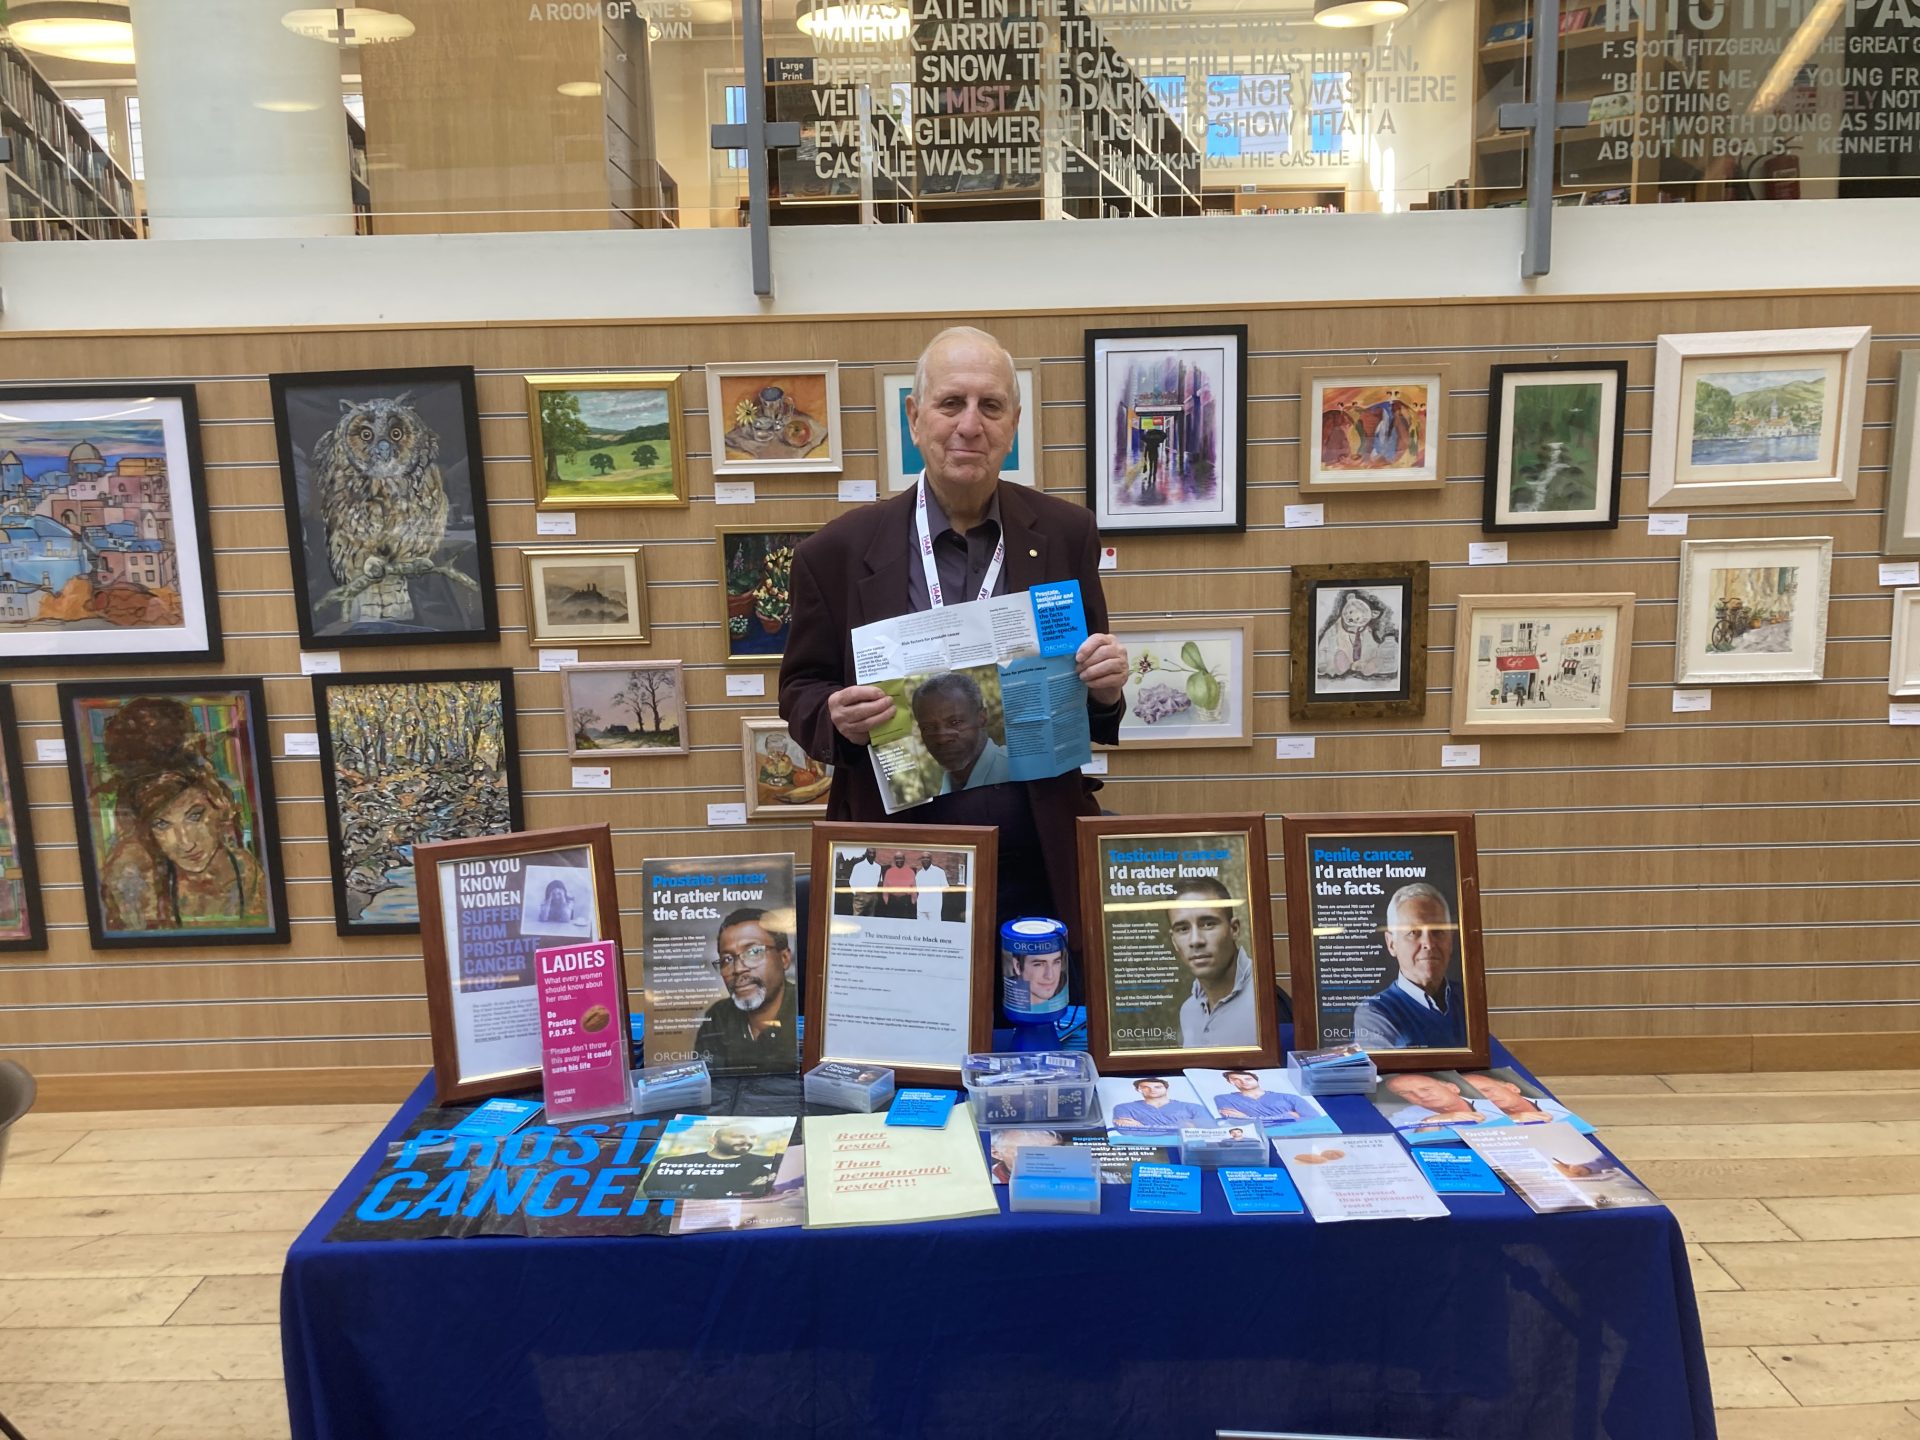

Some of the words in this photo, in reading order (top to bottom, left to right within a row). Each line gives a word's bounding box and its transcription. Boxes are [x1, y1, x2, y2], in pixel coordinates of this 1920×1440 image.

[529, 3, 543, 21] A
[546, 3, 600, 21] ROOM
[607, 2, 631, 19] OF
[981, 0, 1009, 19] IN
[932, 21, 1049, 50] ARRIVED
[1060, 21, 1114, 48] THE
[1602, 41, 1619, 59] F.
[1623, 40, 1676, 58] SCOTT
[1850, 36, 1910, 54] GREAT
[780, 61, 804, 72] Large
[813, 57, 883, 85] DEEP
[922, 54, 1012, 82] SNOW.
[1017, 53, 1071, 80] THE
[1251, 48, 1304, 74] HAS
[782, 71, 803, 81] Print
[1807, 67, 1883, 88] YOUNG
[913, 87, 940, 114] IN
[946, 85, 1010, 113] MIST
[1014, 84, 1073, 112] AND
[1080, 80, 1231, 111] DARKNESS,
[1239, 79, 1294, 106] NOR
[1300, 77, 1361, 104] WAS
[1367, 75, 1456, 103] THERE
[1635, 93, 1730, 113] NOTHING
[815, 119, 887, 148] EVEN
[891, 119, 912, 146] A
[915, 116, 1040, 145] GLIMMER
[1046, 115, 1082, 142] OF
[1092, 112, 1169, 142] LIGHT
[1215, 110, 1297, 138] SHOW
[1307, 108, 1373, 136] THAT
[1377, 108, 1396, 134] A
[1601, 116, 1666, 138] MUCH
[1673, 114, 1755, 135] WORTH
[1763, 112, 1833, 133] DOING
[1839, 112, 1868, 131] AS
[1597, 139, 1675, 161] ABOUT
[1682, 138, 1704, 158] IN
[1817, 136, 1912, 154] KENNETH
[815, 150, 917, 179] CASTLE
[921, 148, 984, 176] WAS
[988, 147, 1084, 176] THERE.
[1102, 153, 1163, 172] FRANZ
[1166, 151, 1233, 171] KAFKA,
[1239, 151, 1275, 168] THE
[1280, 149, 1350, 168] CASTLE
[1109, 848, 1179, 864] Testicular
[1182, 847, 1232, 862] cancer.
[1314, 847, 1361, 862] Penile
[1363, 848, 1414, 862] cancer.
[460, 861, 486, 876] DID
[490, 858, 520, 874] YOU
[1109, 865, 1128, 880] I'd
[1130, 864, 1175, 880] rather
[1178, 864, 1218, 878] know
[1315, 864, 1334, 879] I'd
[1337, 864, 1383, 879] rather
[1386, 864, 1426, 879] know
[460, 875, 507, 893] KNOW
[652, 873, 714, 889] Prostate
[718, 872, 769, 887] cancer.
[1110, 882, 1135, 896] the
[1137, 881, 1178, 896] facts.
[1316, 881, 1341, 896] the
[1344, 880, 1385, 896] facts.
[460, 890, 521, 909] WOMEN
[652, 890, 672, 905] I'd
[674, 889, 720, 905] rather
[723, 888, 763, 902] know
[462, 906, 520, 925] SUFFER
[653, 907, 678, 921] the
[680, 905, 721, 920] facts.
[463, 923, 507, 942] FROM
[864, 931, 875, 939] The
[922, 936, 938, 944] black
[463, 937, 541, 959] PROSTATE
[1014, 942, 1051, 951] ORCHID
[464, 955, 526, 974] CANCER
[542, 949, 605, 974] LADIES
[544, 976, 561, 985] What
[562, 975, 579, 983] every
[580, 971, 603, 980] women
[545, 985, 566, 994] should
[568, 983, 584, 991] know
[586, 980, 603, 989] about
[546, 995, 556, 1003] her
[547, 1011, 557, 1019] Do
[548, 1019, 577, 1029] Practise
[1116, 1027, 1162, 1039] ORCHID
[1323, 1028, 1369, 1039] ORCHID
[550, 1046, 571, 1055] Please
[589, 1041, 607, 1050] throw
[654, 1050, 699, 1062] ORCHID
[551, 1056, 563, 1065] this
[564, 1054, 580, 1063] away
[593, 1049, 612, 1058] could
[551, 1066, 567, 1074] save
[579, 1062, 591, 1070] life
[394, 1119, 661, 1168] PROST
[836, 1131, 887, 1141] Better
[656, 1168, 684, 1176] the
[686, 1168, 725, 1176] facts
[658, 1161, 705, 1169] Prostate
[835, 1159, 881, 1169] Than
[838, 1165, 952, 1182] permanently
